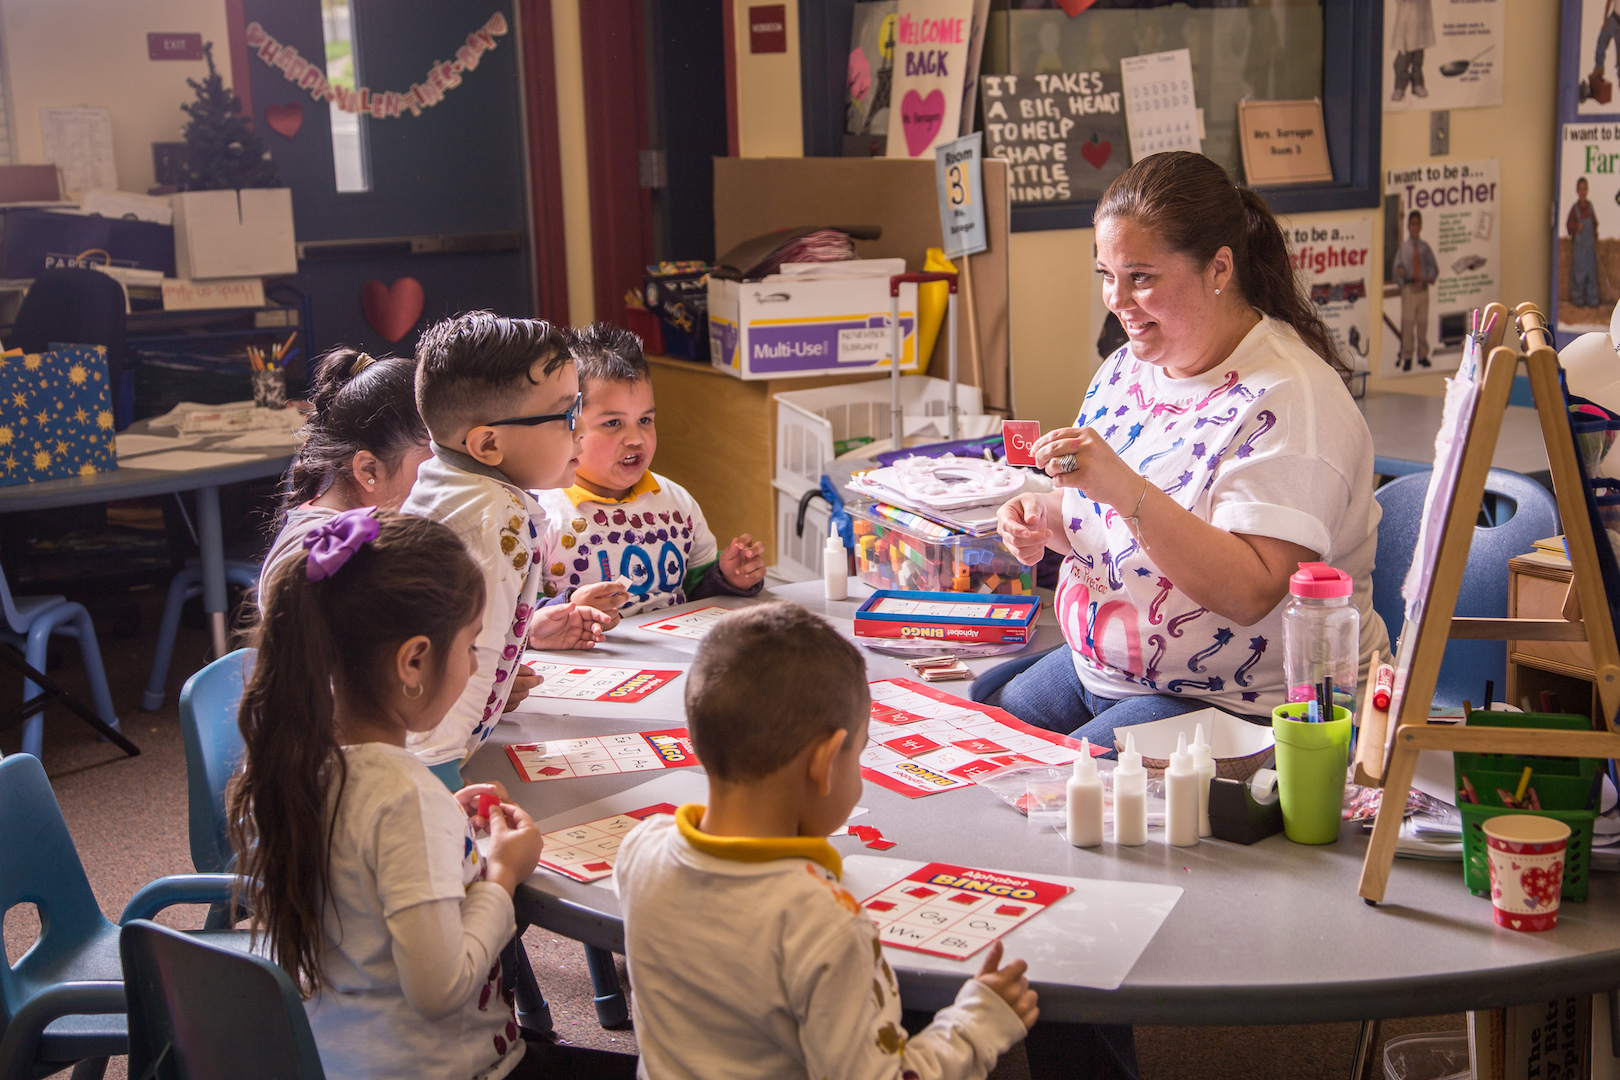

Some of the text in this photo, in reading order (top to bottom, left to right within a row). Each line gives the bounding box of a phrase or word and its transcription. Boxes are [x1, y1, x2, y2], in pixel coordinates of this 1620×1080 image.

[898, 14, 966, 44] WELCOME
[163, 39, 187, 50] EXIT
[905, 50, 949, 77] BACK
[985, 72, 1104, 96] IT TAKES
[987, 101, 1008, 119] A
[1019, 98, 1061, 120] BIG
[1069, 92, 1121, 116] HEART
[988, 119, 1075, 143] TO HELP
[1570, 125, 1598, 141] want
[1601, 124, 1612, 140] to
[945, 148, 973, 167] Room
[992, 142, 1068, 164] SHAPE
[949, 165, 965, 205] 3
[1009, 163, 1070, 184] ITTLE
[1393, 167, 1422, 184] want
[1426, 166, 1440, 181] to
[1443, 164, 1459, 180] be
[1405, 180, 1497, 209] Teacher
[1294, 228, 1308, 243] to
[1311, 226, 1328, 242] be
[1288, 245, 1368, 275] efighter
[753, 341, 823, 359] Multi-Use
[1070, 564, 1081, 579] rs.
[900, 625, 979, 638] Alphabet BINGO
[1060, 583, 1144, 677] 00
[606, 673, 657, 698] BINGO
[646, 734, 687, 763] BNGO
[902, 738, 924, 750] Hh
[895, 763, 959, 786] BINGO
[928, 874, 1038, 900] BINGO
[962, 870, 1030, 888] Alphabet
[920, 911, 996, 932] Gg Oo
[889, 926, 969, 949] Ww Bb
[1544, 999, 1558, 1056] Bits
[1528, 1027, 1541, 1080] The
